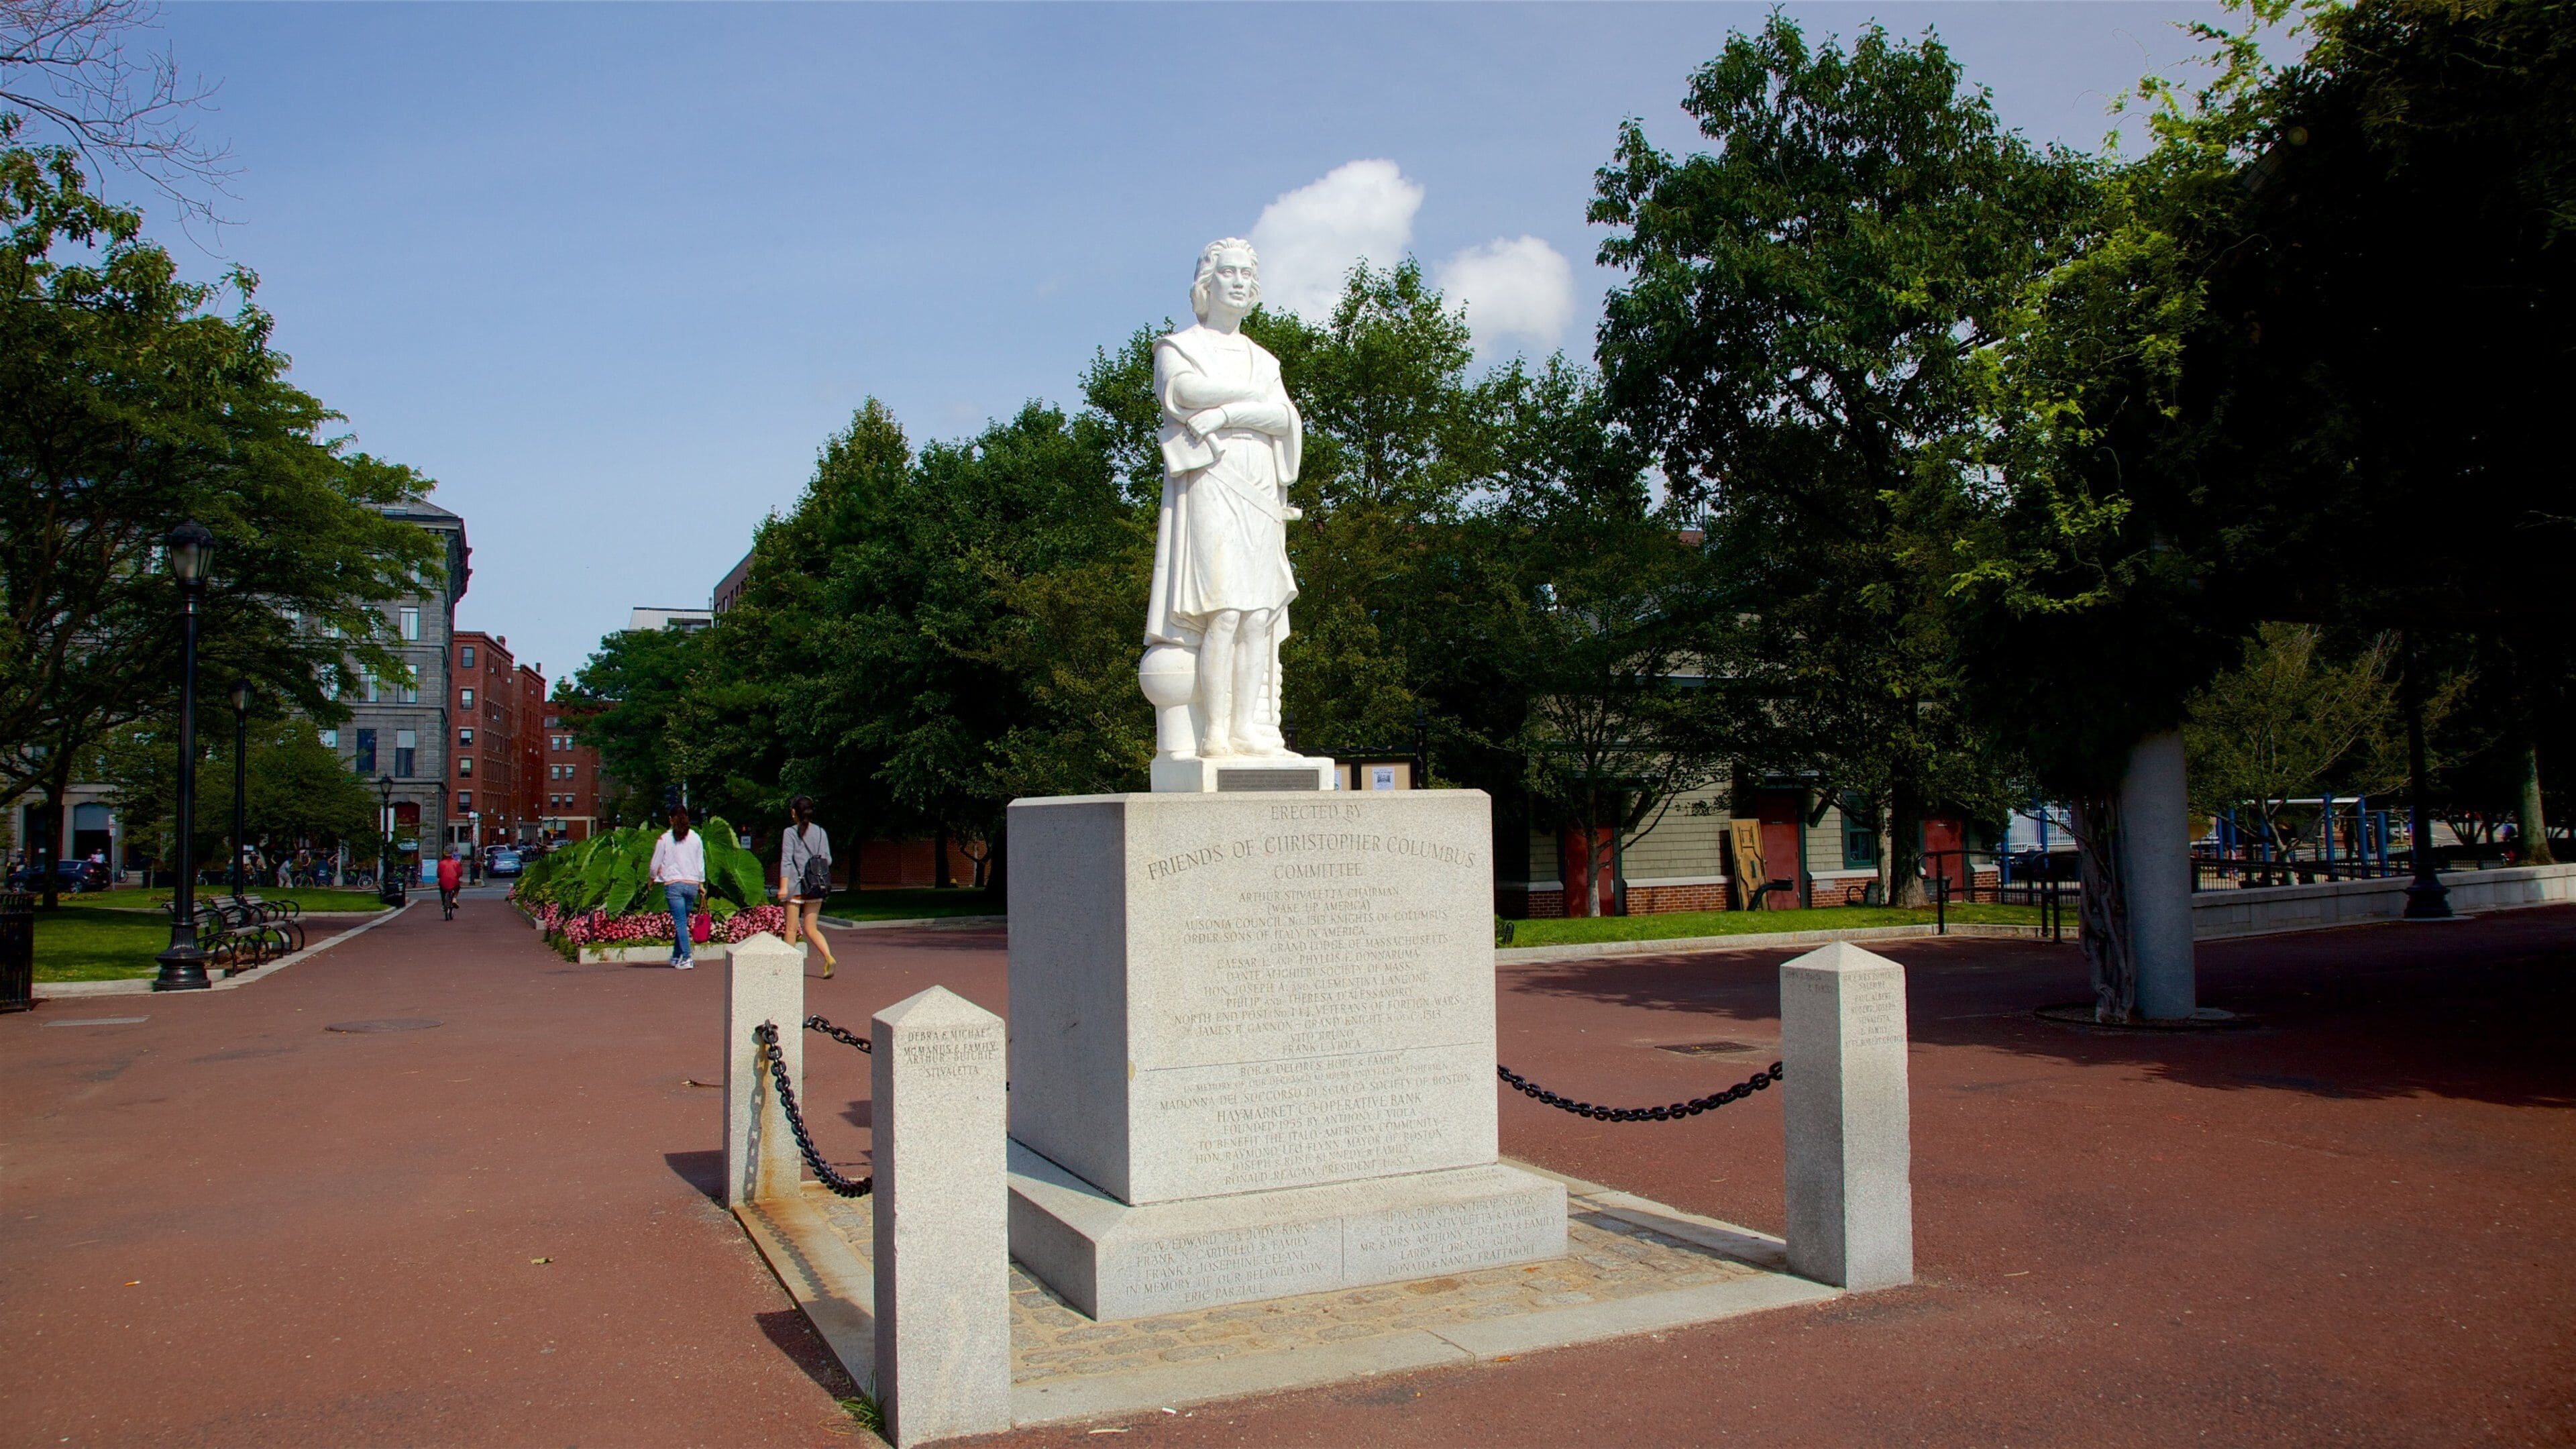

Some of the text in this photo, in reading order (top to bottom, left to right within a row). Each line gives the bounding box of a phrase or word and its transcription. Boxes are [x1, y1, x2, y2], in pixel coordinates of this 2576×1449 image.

[1271, 804, 1361, 820] ERECTED BY
[1148, 833, 1476, 880] FRIENDS OF CHRISTOPHER COLUMBUS
[1274, 863, 1363, 879] COMMITTEE
[1238, 890, 1280, 902] ARTHUR
[1284, 889, 1343, 900] STIVALETTA
[1305, 902, 1318, 912] UP
[1324, 900, 1371, 912] AMERICA)
[1184, 918, 1232, 930] AUSONIA
[1235, 916, 1282, 928] COUNCIL
[1330, 913, 1375, 924] KNIGHTS
[1377, 913, 1388, 923] OF
[1394, 910, 1448, 922] COLUMBUS
[1183, 933, 1219, 945] ORDER
[1223, 930, 1252, 943] SONS
[1256, 930, 1269, 941] OF
[1275, 928, 1301, 940] ITALY
[1307, 928, 1318, 938] IN
[1270, 934, 1449, 953] GRAND LODGE OF MASSACHUSETTS
[1217, 957, 1257, 969] CAESAR
[1299, 953, 1340, 965] PHYLLIS
[1226, 970, 1260, 981] DANTE
[1266, 967, 1316, 979] ALIGHIERI
[1320, 965, 1362, 977] SOCIETY
[1367, 963, 1379, 973] OF
[1232, 983, 1274, 996] JOSEPH
[1288, 992, 1333, 1005] THERESA
[1174, 995, 1460, 1025] NORTH END POST VETERANS OF FOREIGN WARS
[908, 1030, 939, 1042] DEBRA
[1195, 1025, 1232, 1038] JAMES
[1246, 1021, 1292, 1034] GANNON
[1304, 1017, 1340, 1030] GRAND
[1282, 1042, 1316, 1055] FRANK
[925, 1065, 979, 1077] STIVALETTA
[1328, 1057, 1354, 1070] HOPE
[1160, 1097, 1216, 1110] MADONNA
[1219, 1094, 1238, 1106] DEL
[1243, 1088, 1302, 1104] SOCCORSO
[1369, 1078, 1411, 1091] SOCIETY
[1415, 1076, 1428, 1087] OF
[1432, 1073, 1472, 1085] BOSTON
[1217, 1092, 1423, 1123] HAYMARKET CO-OPERATIVE BANK
[1223, 1120, 1275, 1135] FOUNDED
[1307, 1116, 1318, 1127] BY
[1324, 1111, 1372, 1125] ANTHONY
[1199, 1140, 1213, 1151] TO
[1216, 1136, 1258, 1149] BENEFIT
[1265, 1132, 1284, 1144] THE
[1379, 1117, 1439, 1132] COMMUNITY
[1226, 1146, 1278, 1161] RAYMOND
[1346, 1134, 1381, 1148] MAYOR
[1385, 1132, 1397, 1143] OF
[1403, 1128, 1442, 1142] BOSTON
[1225, 1159, 1376, 1186] RONALD REAGAN PRESIDENT
[1232, 1158, 1271, 1171] JOSEPH
[1416, 1205, 1442, 1219] JOHN
[1503, 1193, 1534, 1207] SEARS
[1171, 1234, 1218, 1250] EDWARD
[1246, 1226, 1275, 1240] JODY
[1282, 1222, 1308, 1236] KING
[1380, 1225, 1393, 1236] ED
[1417, 1230, 1462, 1244] ANTHONY
[1136, 1252, 1175, 1267] FRANK
[1196, 1242, 1254, 1260] CARDULLO
[1440, 1254, 1472, 1267] NANCY
[1146, 1265, 1183, 1279] FRANK
[1197, 1256, 1258, 1273] JOSEPHINE
[1126, 1261, 1322, 1296] IN MEMORY OF OUR BELOVED SON
[1184, 1289, 1210, 1303] ERIC
